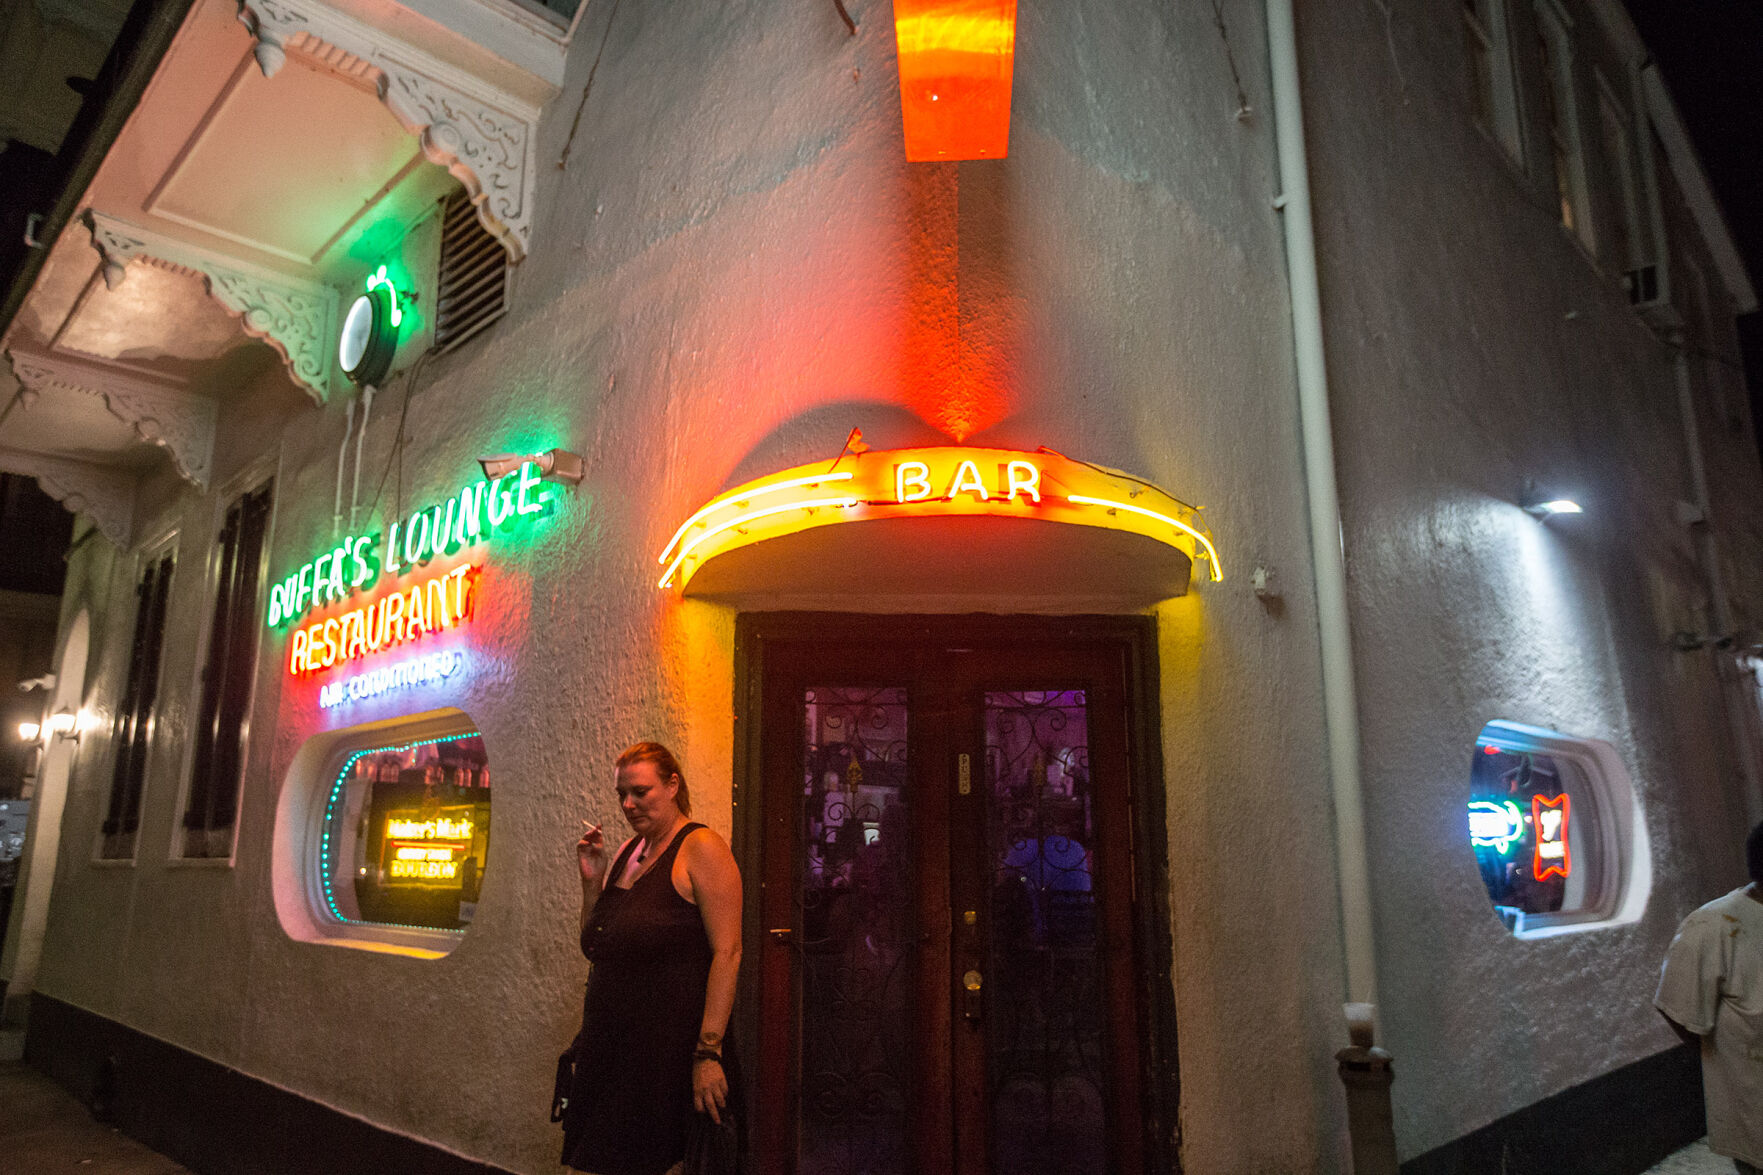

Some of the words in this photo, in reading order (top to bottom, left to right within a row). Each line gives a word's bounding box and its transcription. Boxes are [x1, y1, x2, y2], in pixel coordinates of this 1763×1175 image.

[895, 460, 1042, 504] BAR
[268, 535, 373, 628] BUFFA'S
[385, 461, 544, 573] LOUNGE
[290, 563, 473, 676] RESTAURANT
